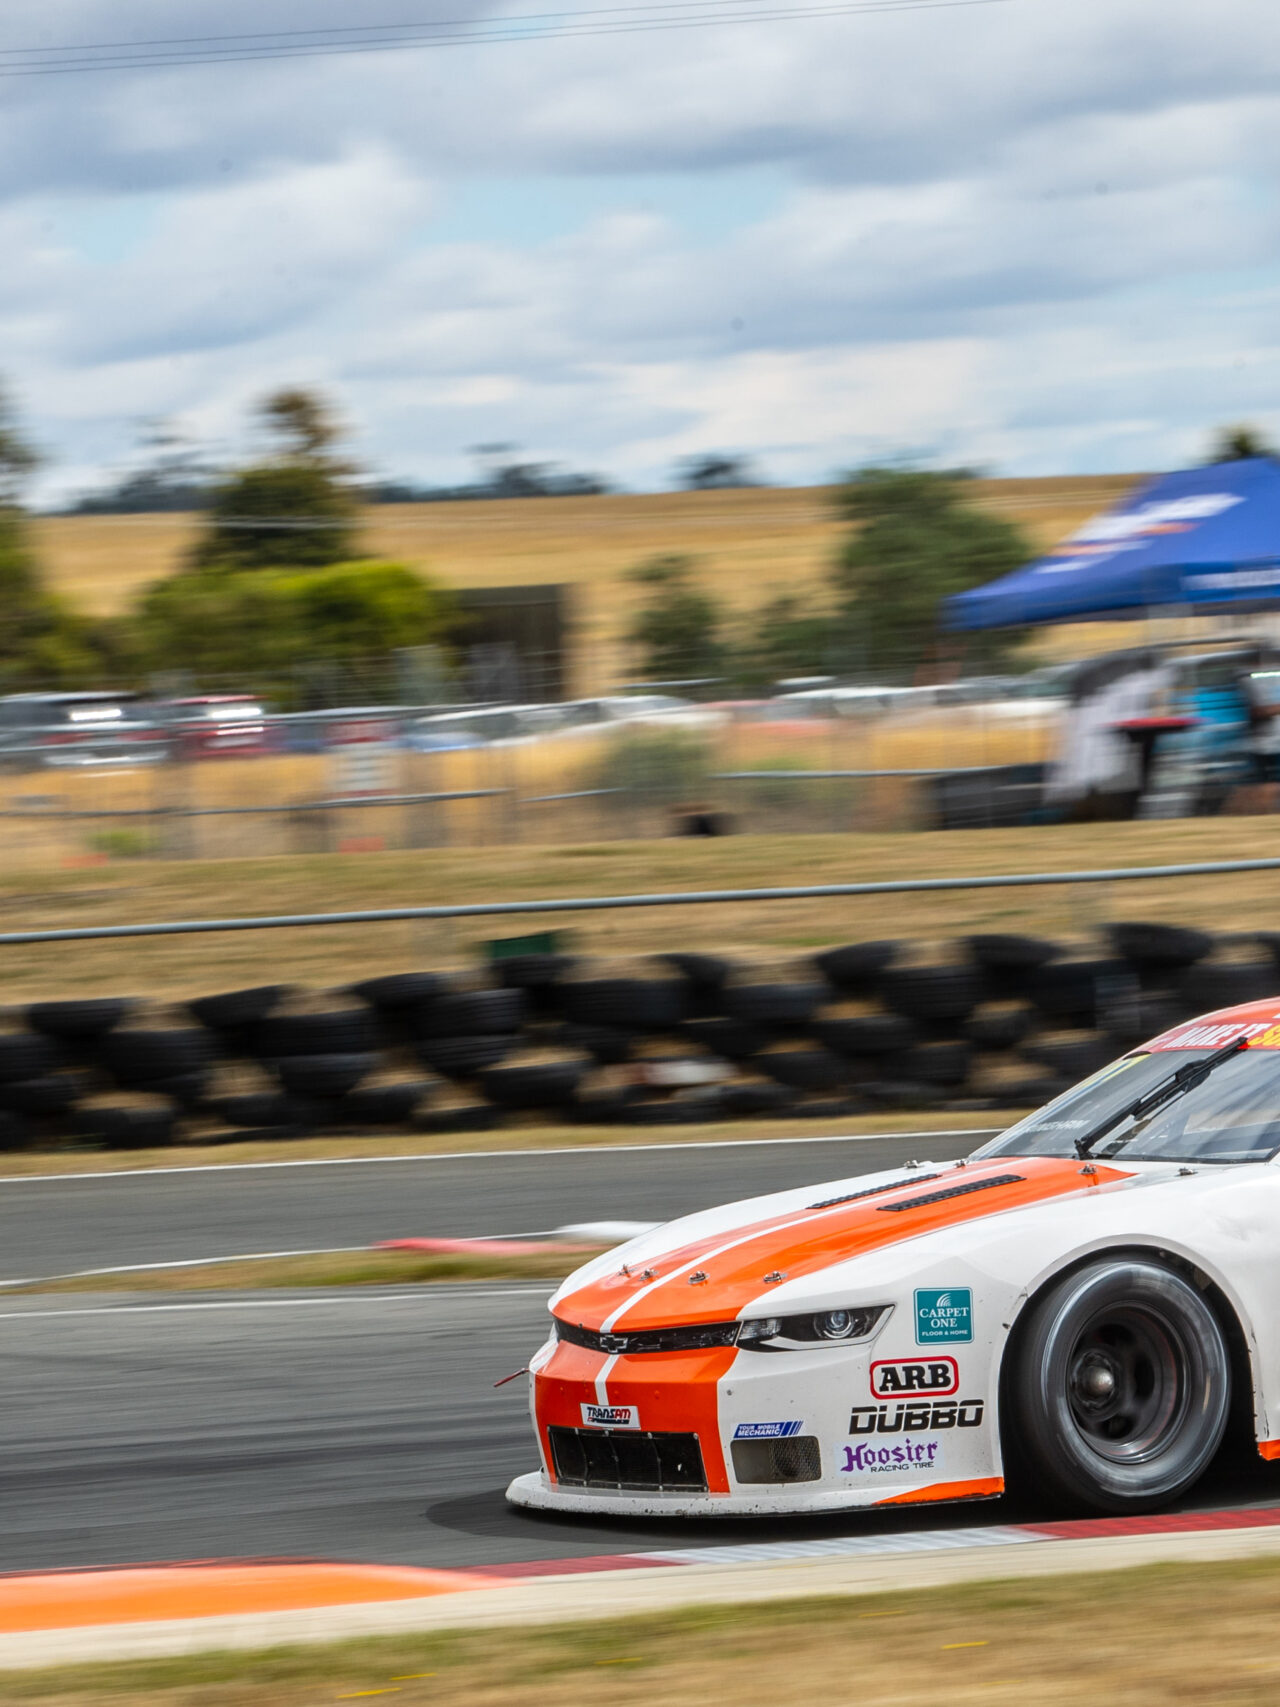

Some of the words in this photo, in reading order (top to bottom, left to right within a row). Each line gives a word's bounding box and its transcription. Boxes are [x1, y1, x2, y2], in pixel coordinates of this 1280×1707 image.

[919, 1307, 969, 1318] CARPET
[930, 1318, 958, 1329] ONE
[879, 1363, 952, 1392] ARB
[848, 1399, 985, 1435] DUBBO
[737, 1429, 780, 1437] MECHANIC
[841, 1438, 938, 1472] Hoosier
[870, 1463, 910, 1473] RACING
[913, 1461, 934, 1469] TIRE
